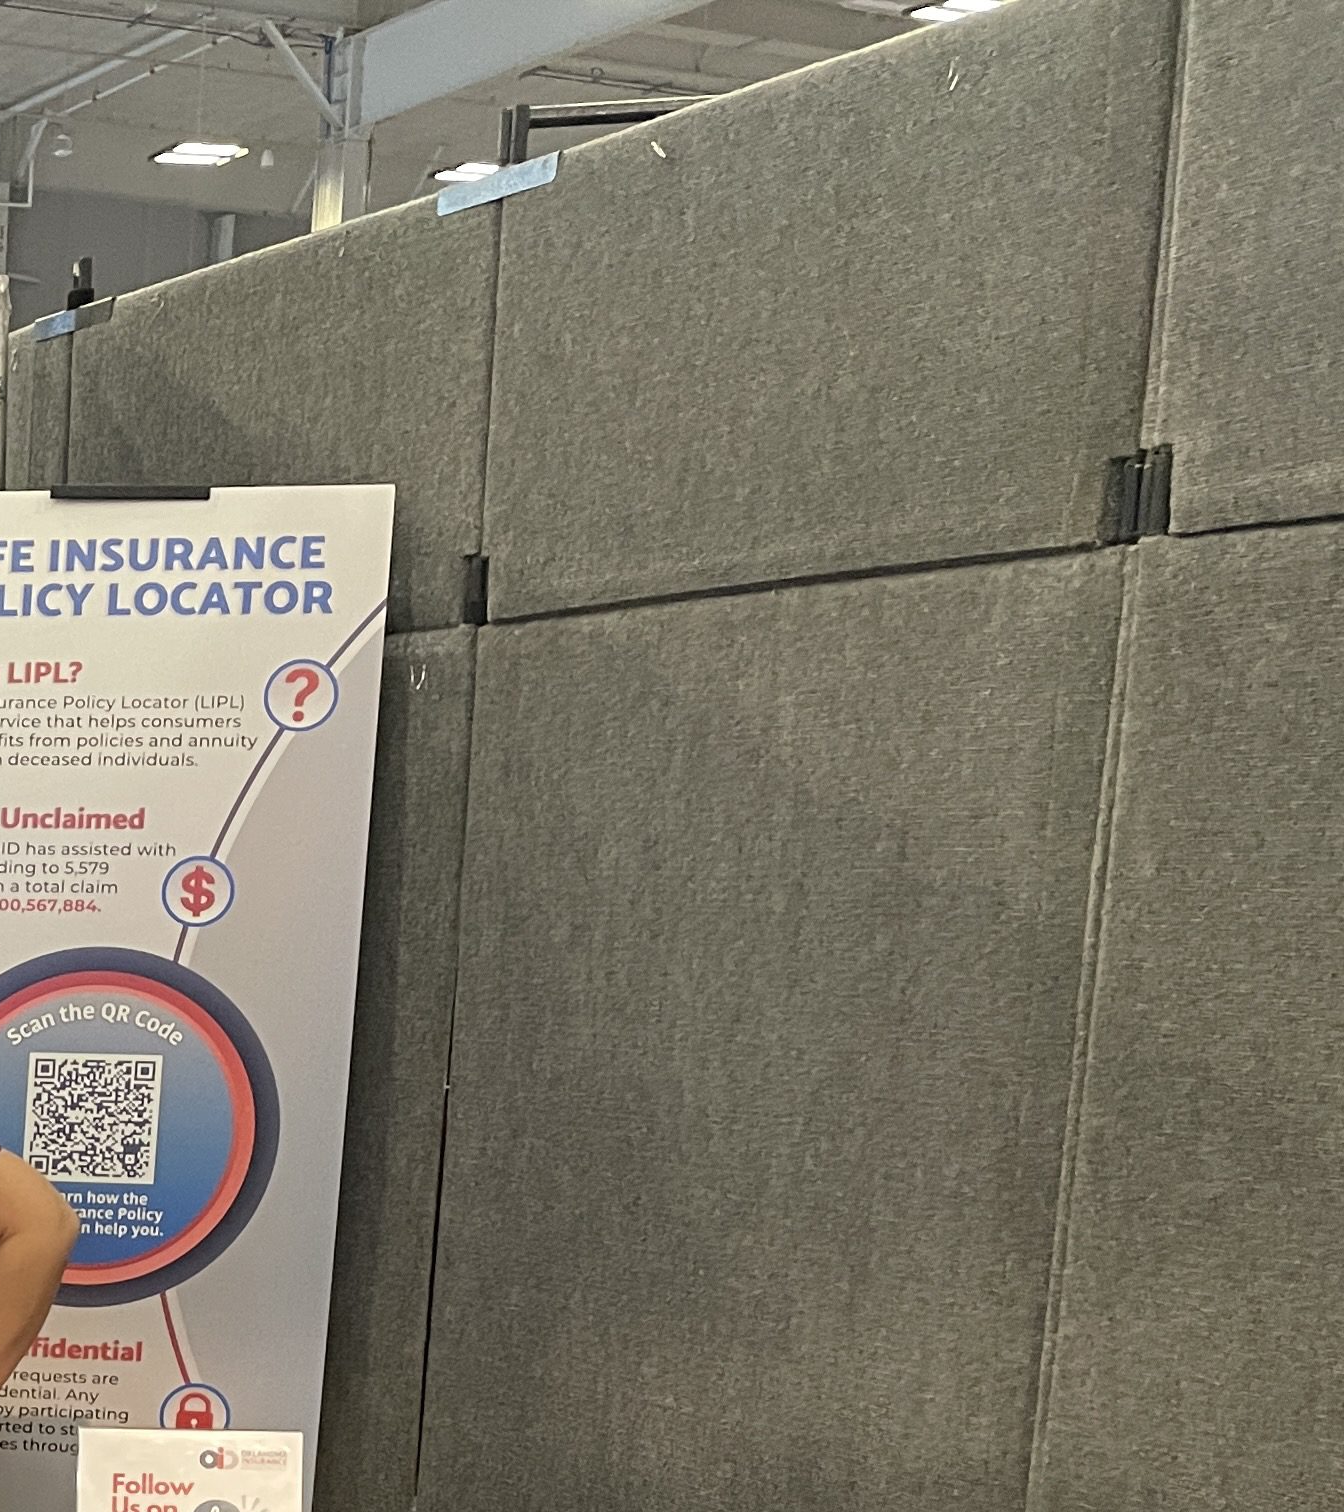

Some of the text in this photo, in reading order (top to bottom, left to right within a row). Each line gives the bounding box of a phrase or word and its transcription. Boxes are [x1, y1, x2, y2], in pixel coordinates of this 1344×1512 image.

[49, 535, 326, 573] INSURANCE
[107, 580, 333, 617] LOCATOR
[7, 661, 83, 684] LIPL?
[63, 695, 116, 712] Policy
[121, 695, 189, 710] Locator
[194, 694, 245, 712] (LIPL)
[46, 714, 83, 729] that
[88, 714, 136, 731] helps
[141, 717, 242, 729] consumers
[0, 806, 146, 830] Unclaimed
[6, 1003, 184, 1046] Scan the QR Code
[111, 1473, 195, 1497] Follow
